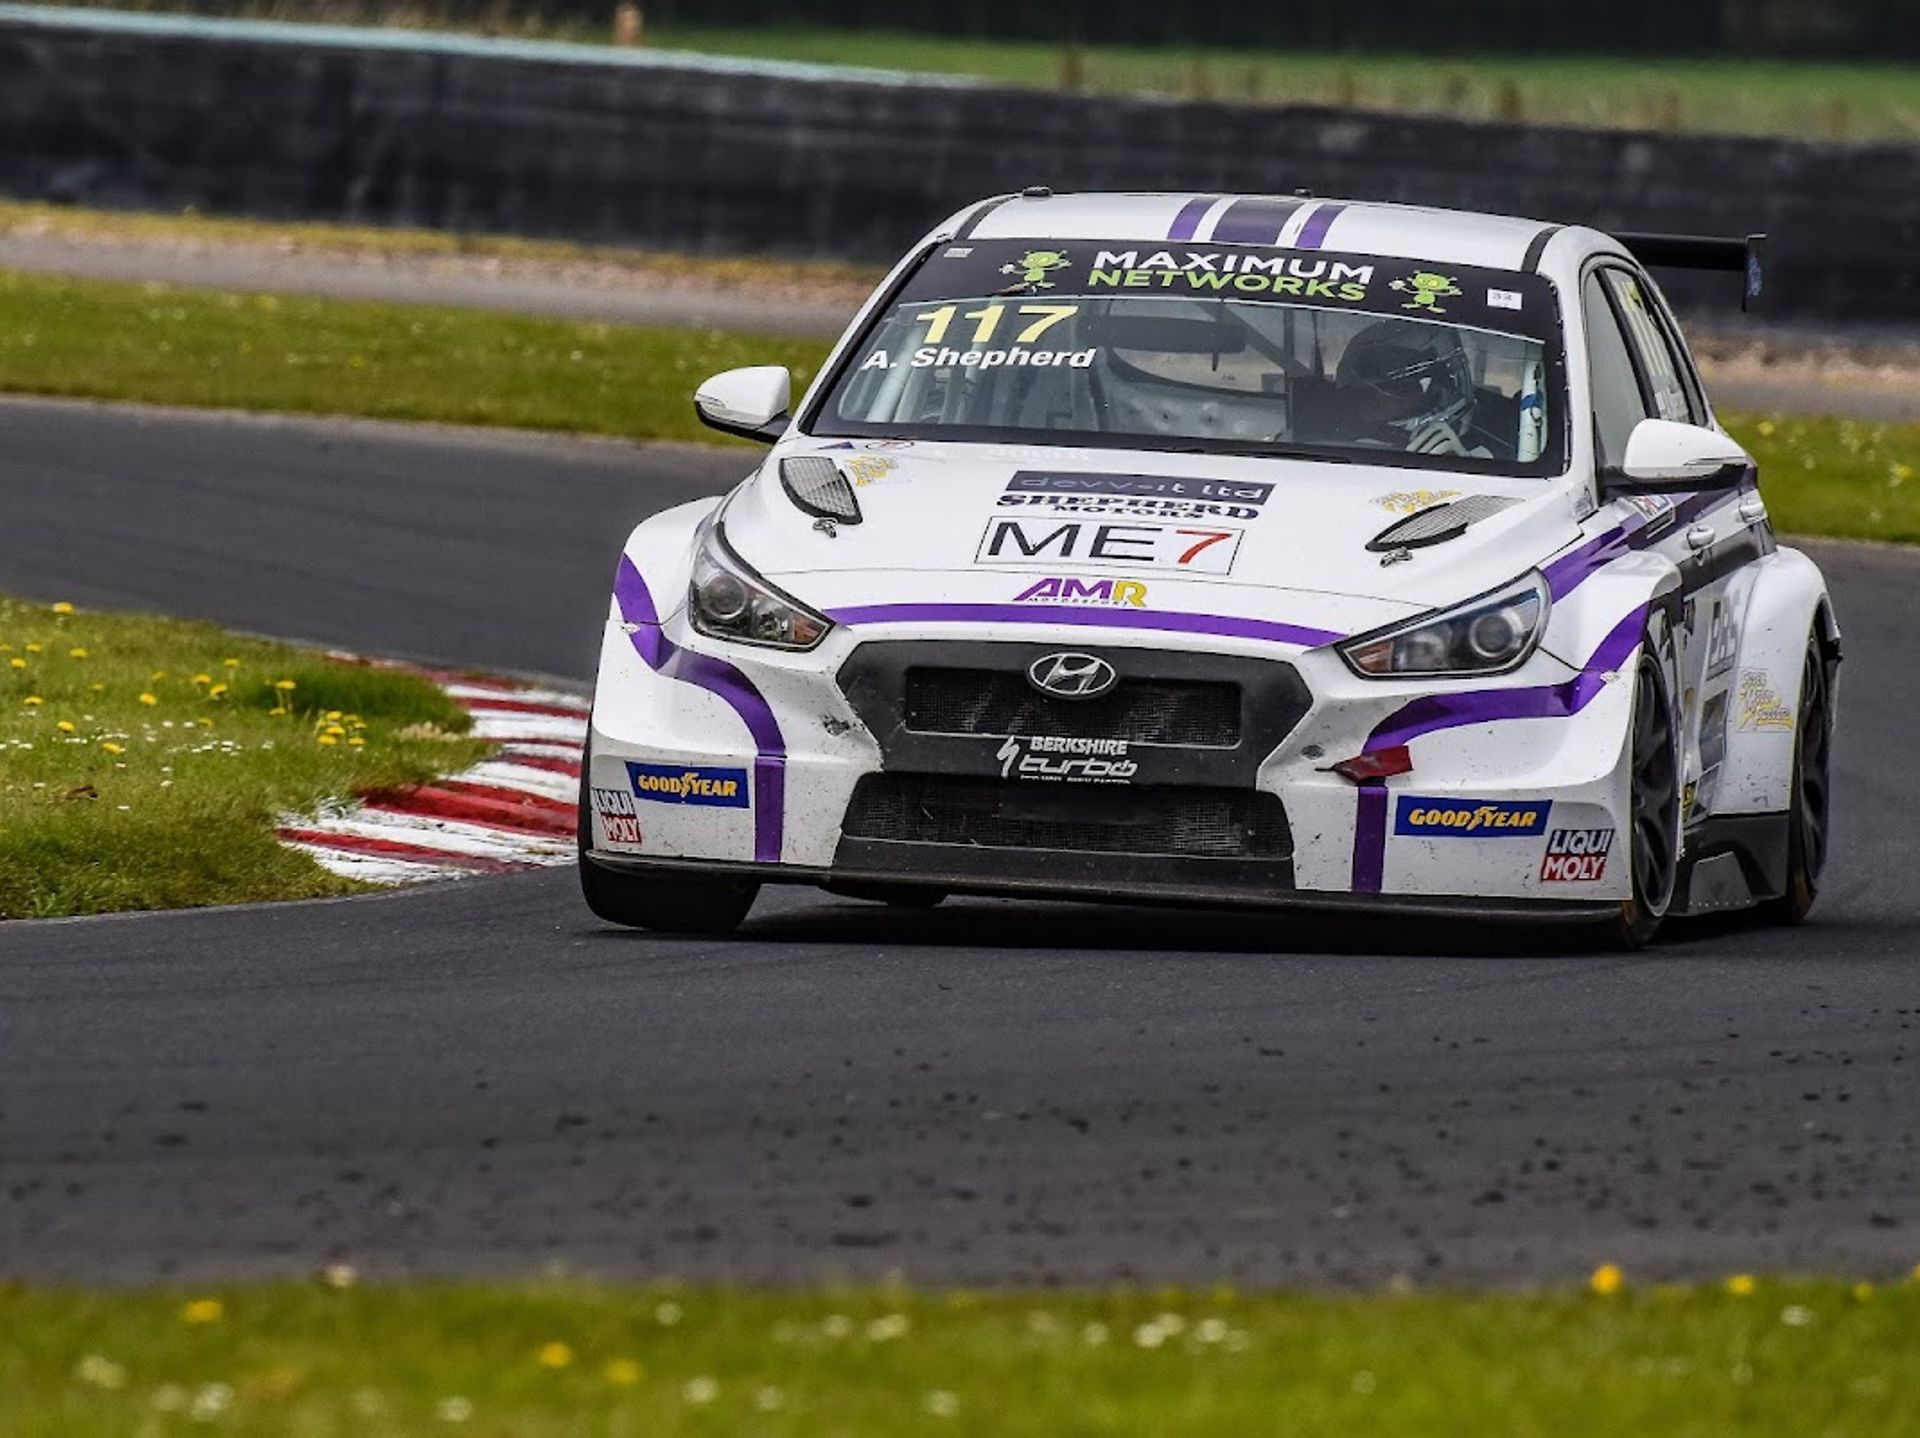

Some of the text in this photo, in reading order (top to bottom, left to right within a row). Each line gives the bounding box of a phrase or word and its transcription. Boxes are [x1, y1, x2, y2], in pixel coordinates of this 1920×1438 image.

[1093, 251, 1374, 284] MAXIMUM
[1088, 270, 1367, 301] NETWORKS
[916, 305, 1079, 344] 117
[861, 346, 1098, 370] A. Shepherd
[997, 495, 1260, 520] SHEPHERD
[1052, 505, 1204, 519] MOTORS
[1012, 578, 1148, 608] AMR
[1030, 736, 1128, 756] BERKSHIRE
[1018, 754, 1138, 777] turbo
[638, 772, 738, 798] GOODYEAR
[592, 791, 635, 815] LIQUI
[602, 816, 640, 842] MOLY
[1408, 806, 1537, 831] GOODYEAR
[1550, 831, 1613, 855] LIQUI
[1543, 856, 1606, 881] MOLY
